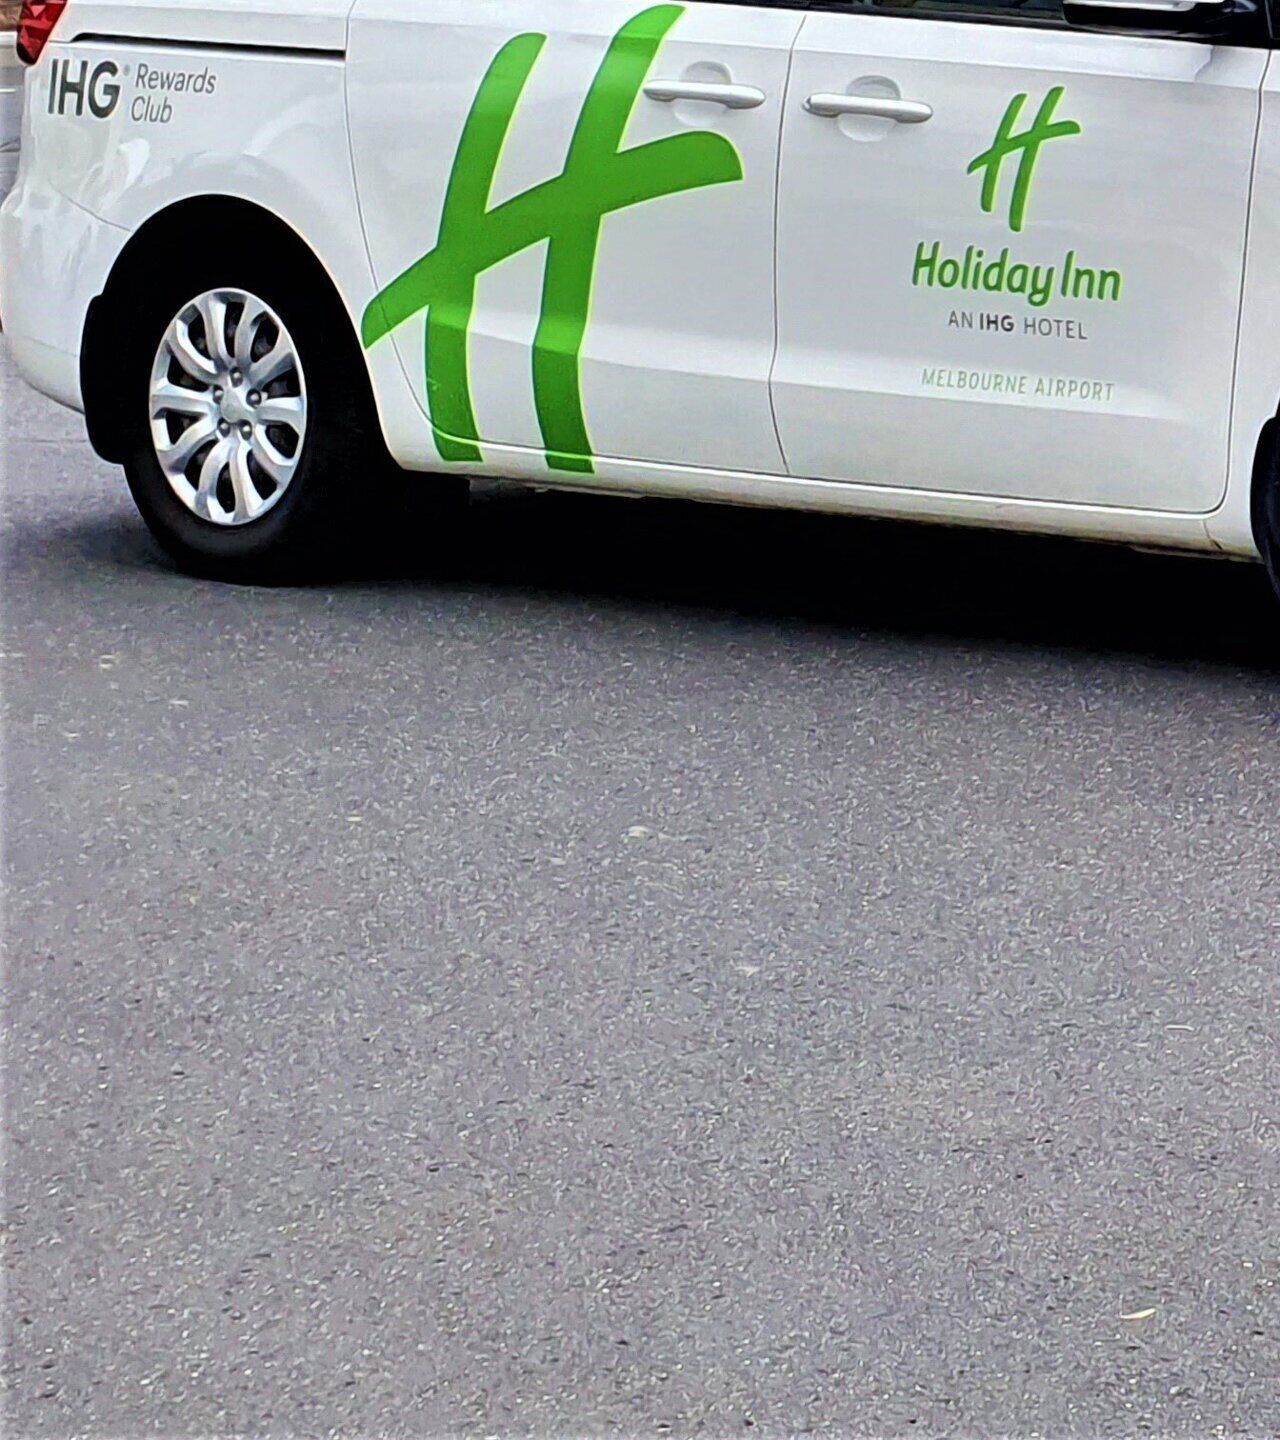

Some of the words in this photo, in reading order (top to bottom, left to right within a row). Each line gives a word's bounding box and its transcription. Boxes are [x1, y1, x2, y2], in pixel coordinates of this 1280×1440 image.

[135, 62, 217, 94] Rewards
[131, 95, 173, 123] Club
[911, 240, 1055, 308] Holiday
[1060, 249, 1122, 302] Inn
[948, 310, 974, 329] AN
[979, 312, 1015, 333] IHG
[1023, 316, 1088, 340] HOTEL
[921, 368, 1028, 395] MELBOURNE
[1034, 377, 1115, 402] AIRPORT
